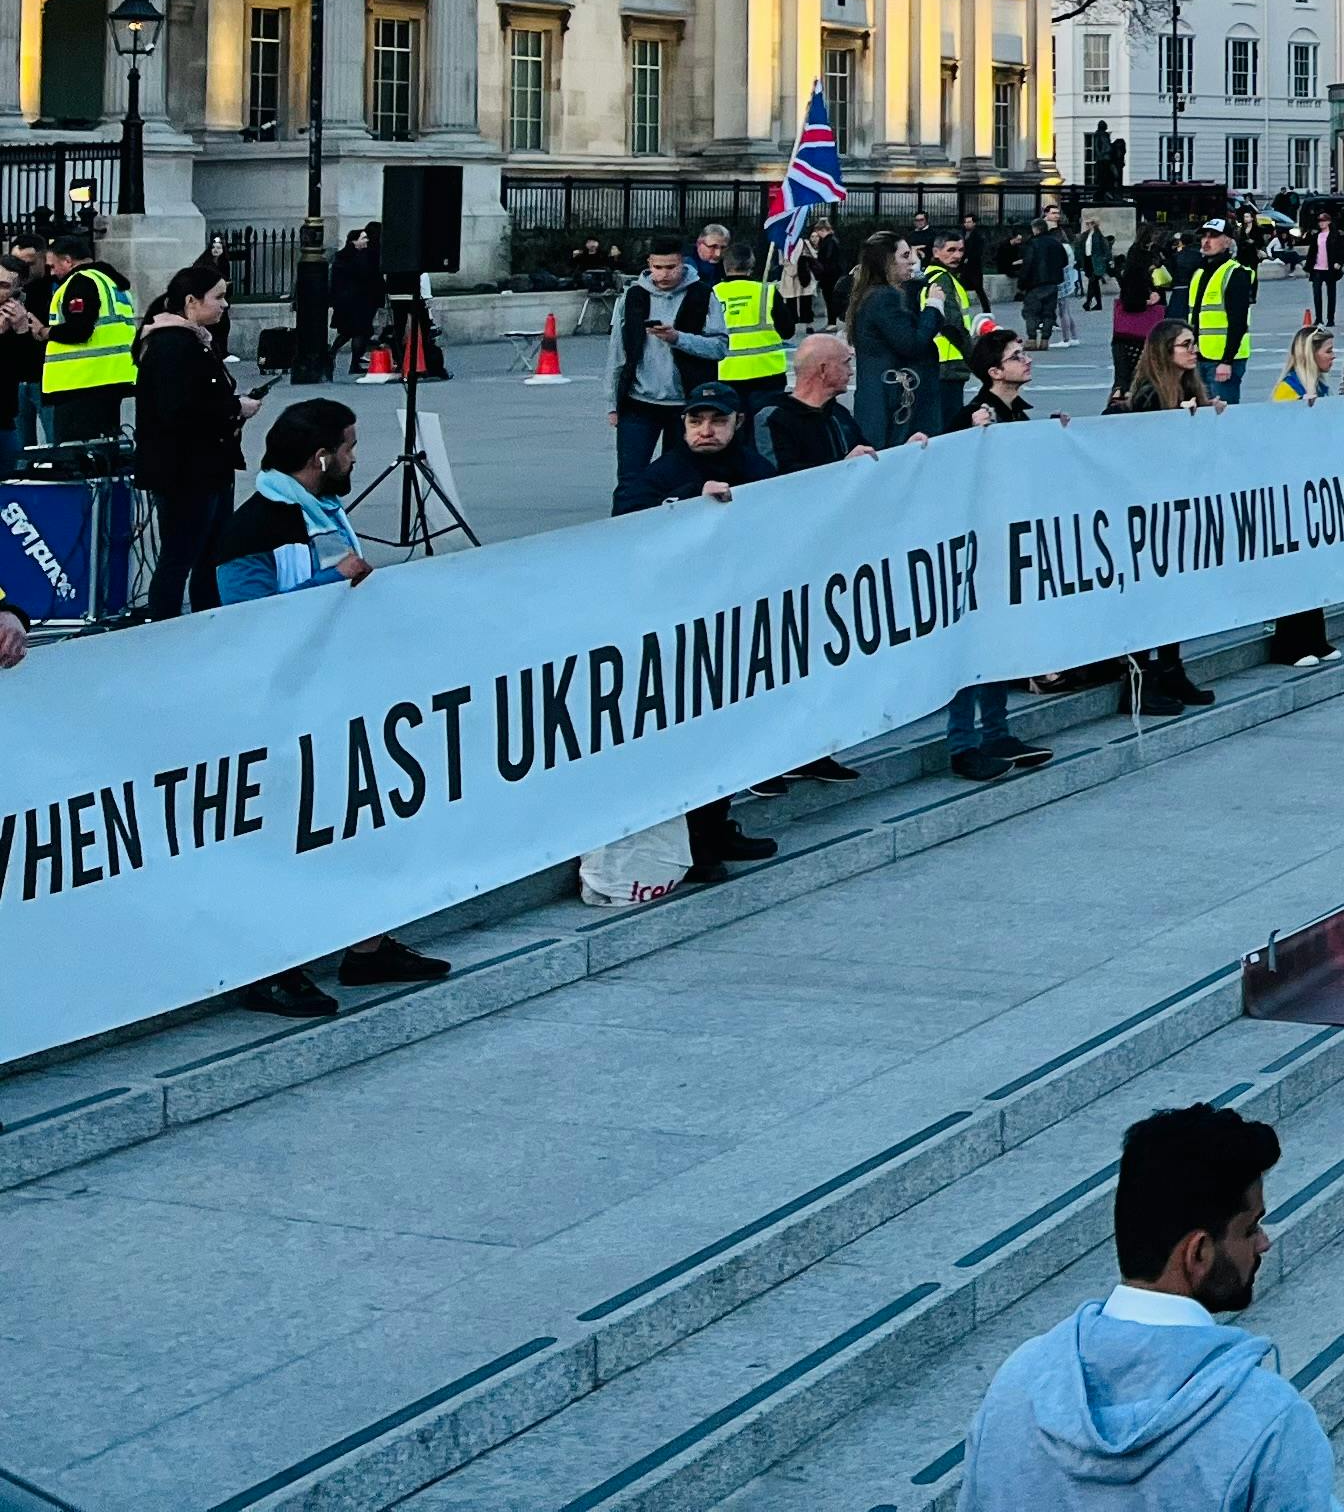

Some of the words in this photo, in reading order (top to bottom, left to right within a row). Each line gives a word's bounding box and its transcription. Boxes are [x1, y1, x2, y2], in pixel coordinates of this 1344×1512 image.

[154, 747, 268, 857] THE
[296, 685, 472, 854] LAST
[495, 584, 809, 782] UKRAINIAN
[823, 529, 978, 666] SOLDIER
[1008, 509, 1125, 605] FALLS,
[1128, 494, 1224, 582] PUTIN
[1230, 484, 1299, 563] WILL
